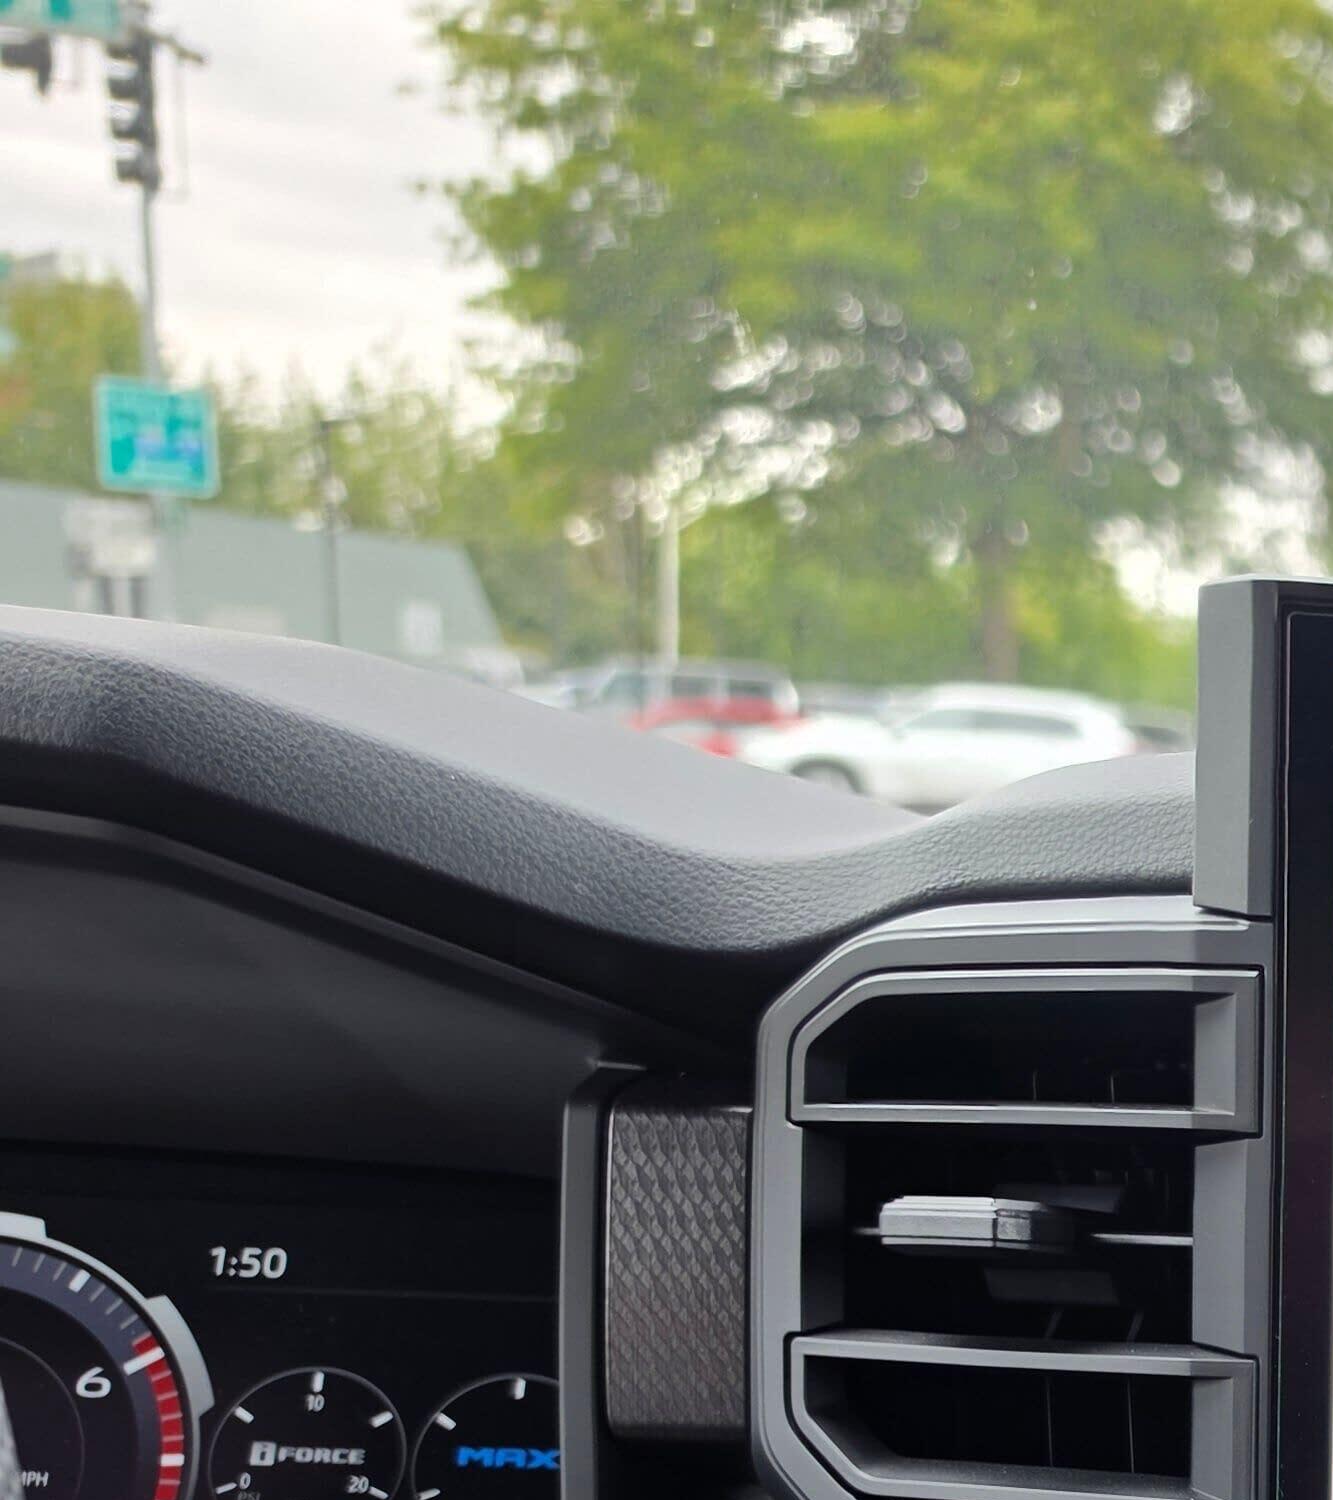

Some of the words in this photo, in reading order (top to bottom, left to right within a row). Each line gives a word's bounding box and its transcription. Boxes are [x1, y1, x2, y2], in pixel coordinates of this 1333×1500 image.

[209, 1246, 288, 1280] 1:50
[75, 1366, 112, 1399] 6
[305, 1394, 325, 1412] 10
[455, 1446, 561, 1469] MAX
[238, 1472, 251, 1490] 0
[346, 1475, 370, 1495] 20
